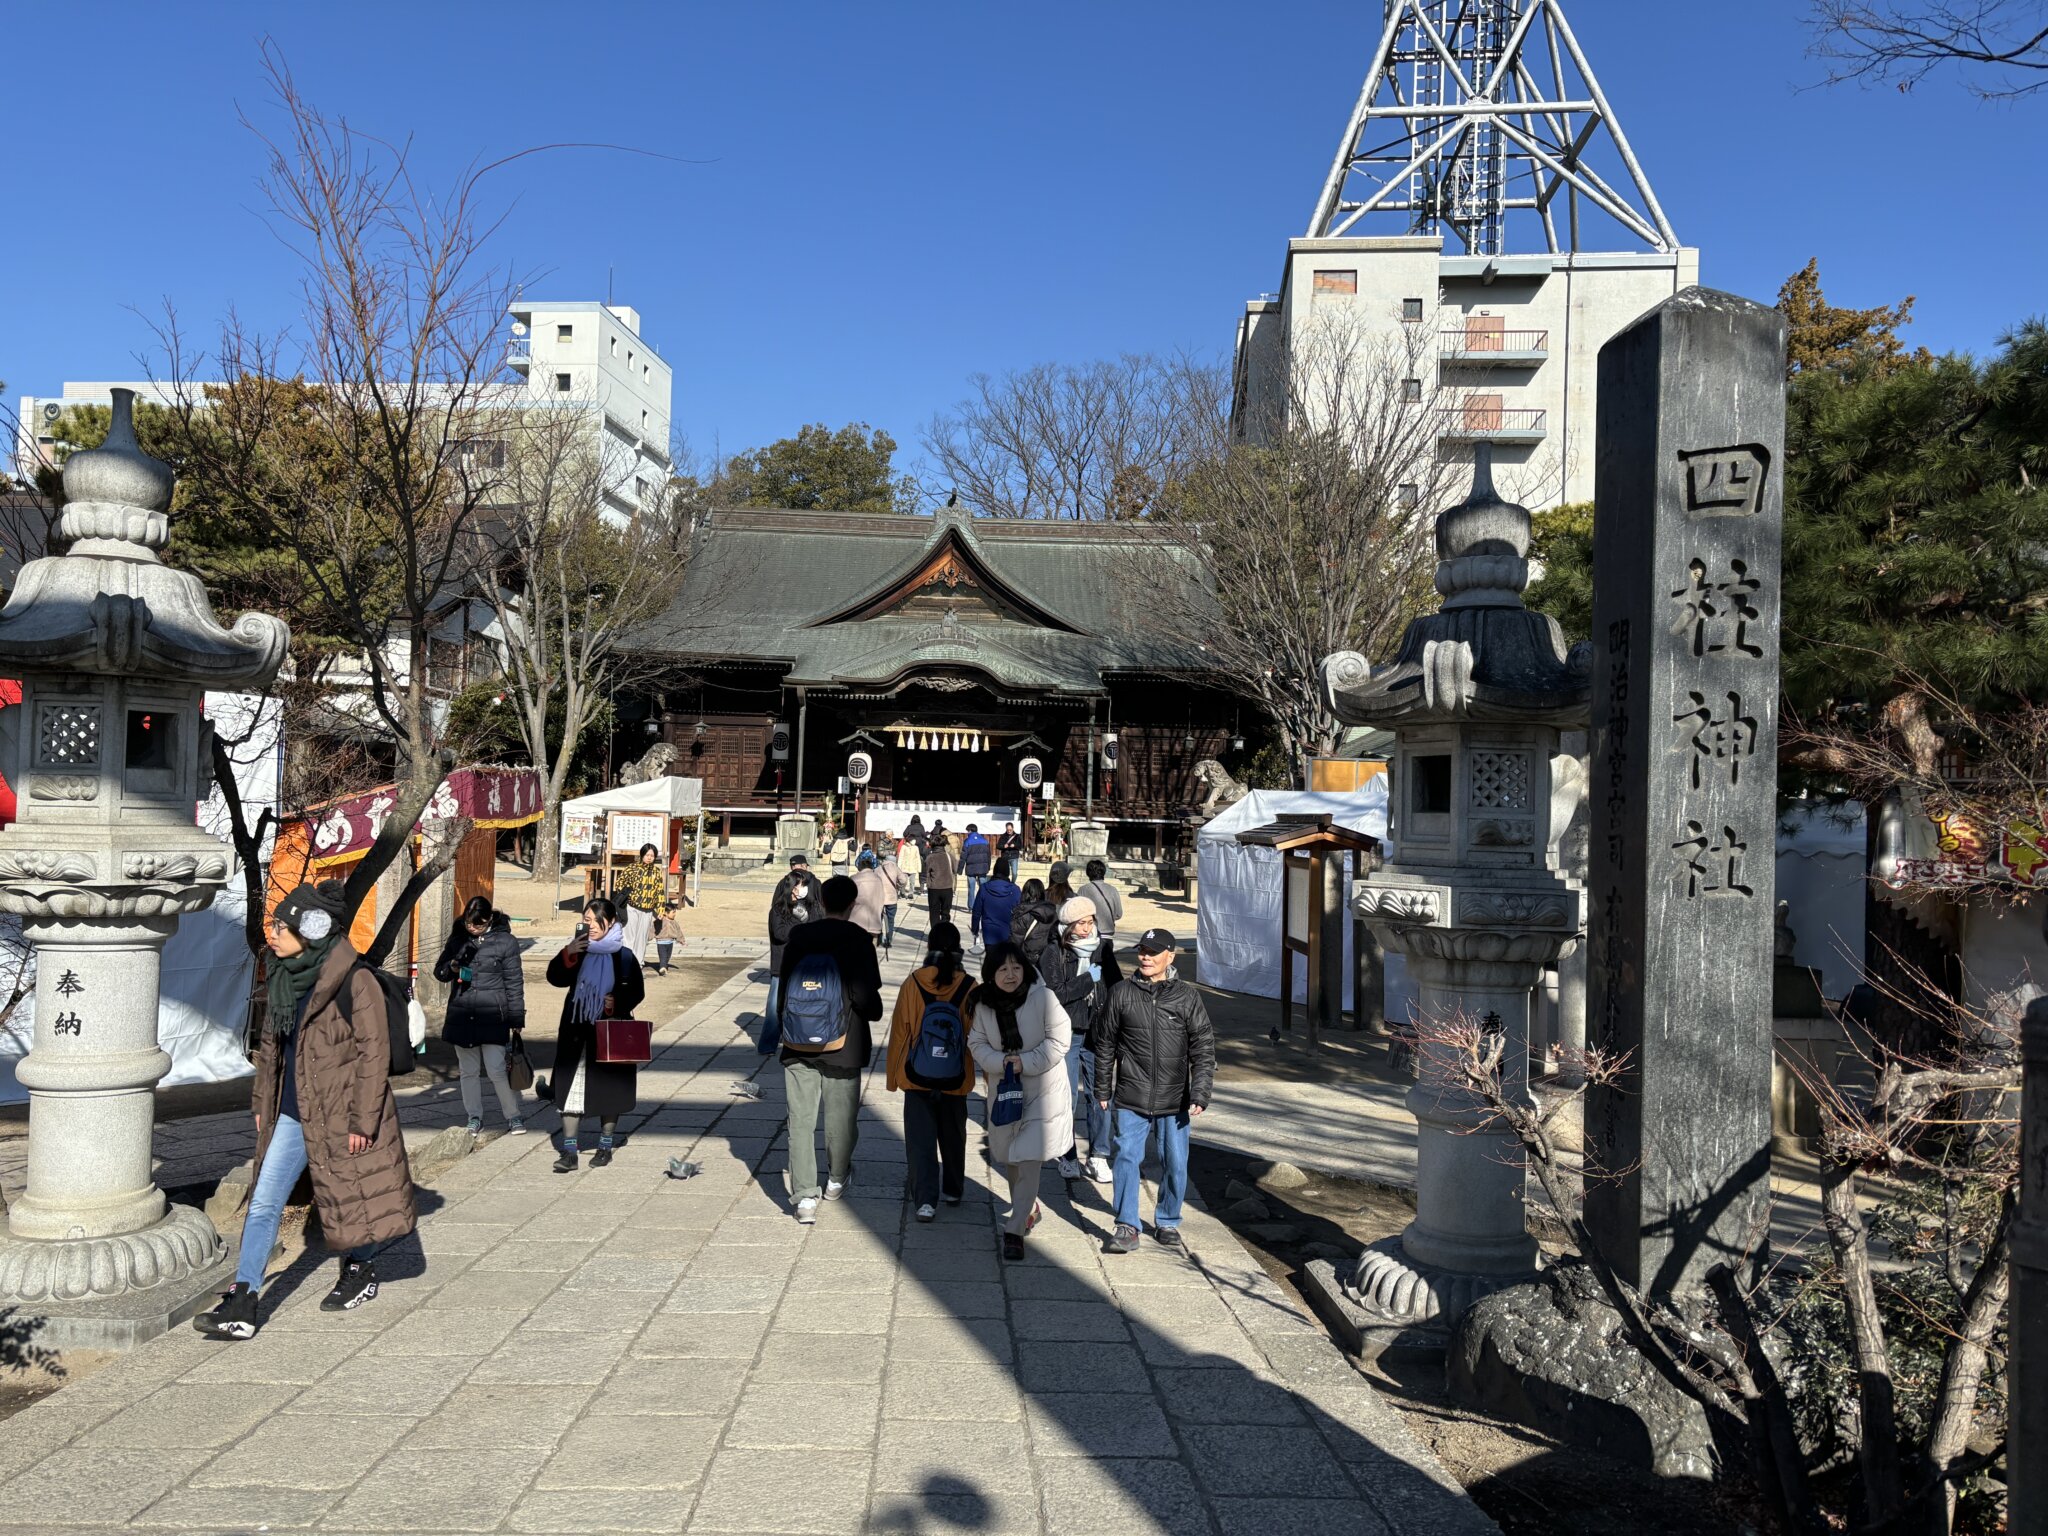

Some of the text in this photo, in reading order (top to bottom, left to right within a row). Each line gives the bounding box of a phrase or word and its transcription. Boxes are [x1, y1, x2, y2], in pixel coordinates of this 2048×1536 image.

[1668, 443, 1771, 899] 四柱神社
[54, 969, 85, 1036] 奉納
